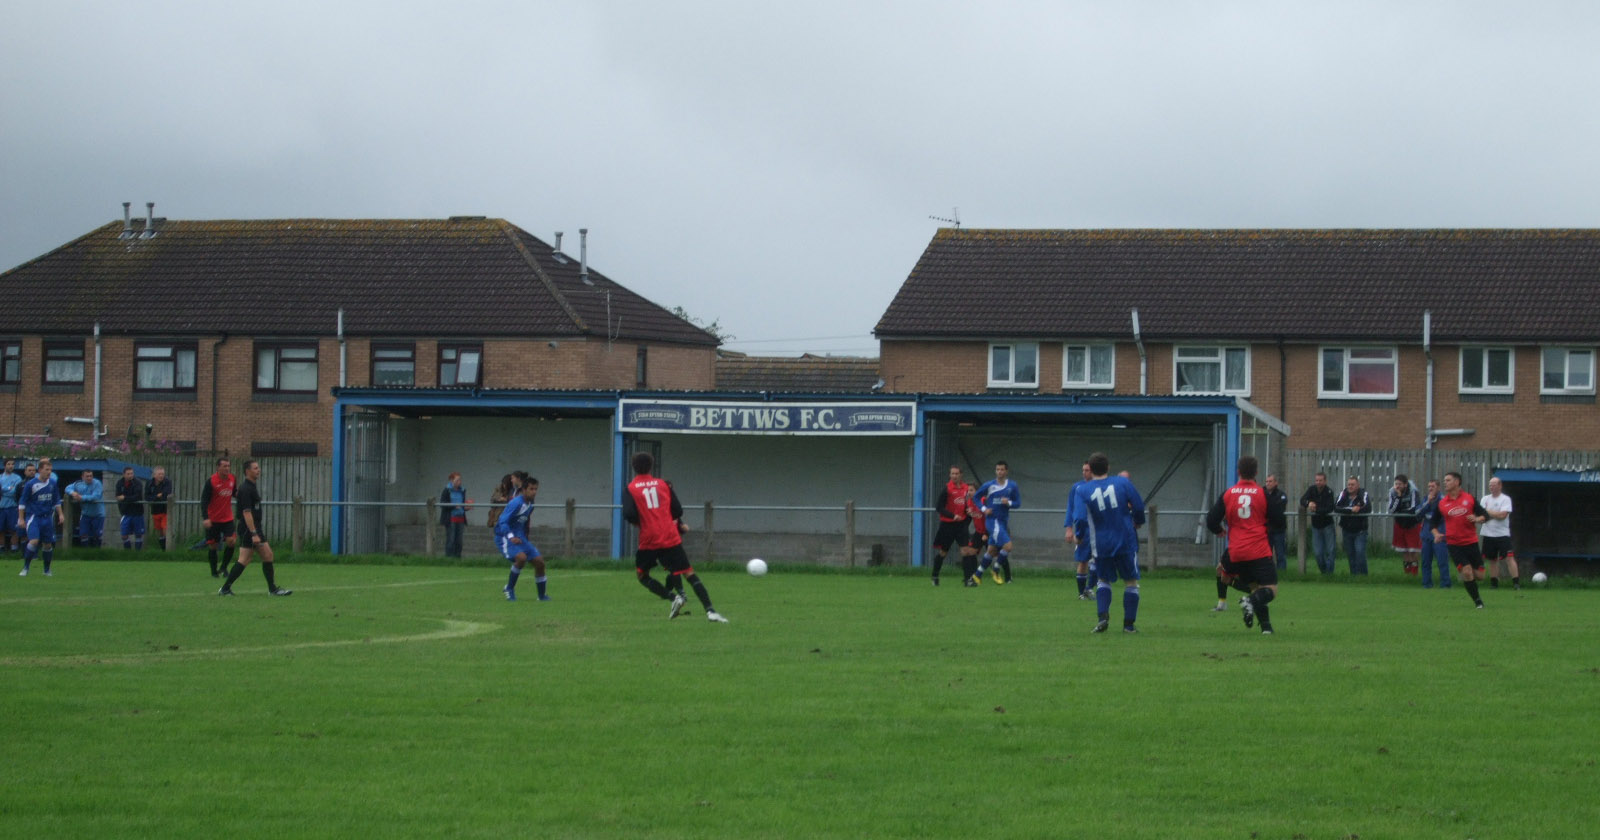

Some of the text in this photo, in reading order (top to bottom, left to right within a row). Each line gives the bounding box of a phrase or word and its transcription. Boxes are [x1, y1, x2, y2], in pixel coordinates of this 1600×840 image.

[689, 407, 841, 429] BETTWS F.C.
[642, 486, 660, 509] 11
[1090, 484, 1118, 512] 11
[1237, 494, 1252, 519] 3
